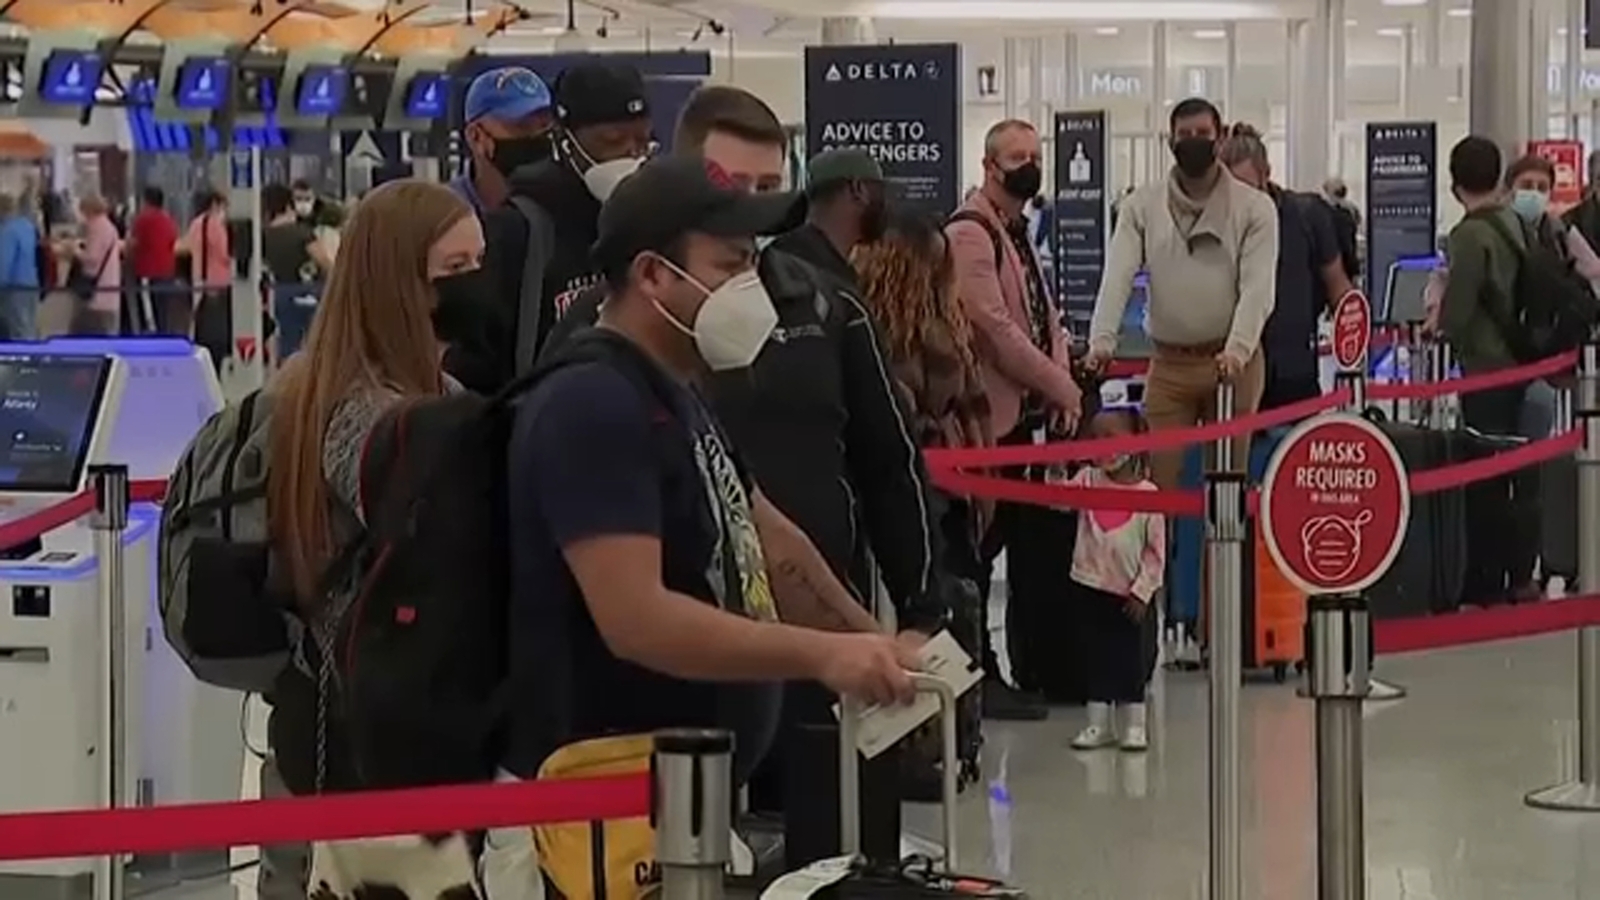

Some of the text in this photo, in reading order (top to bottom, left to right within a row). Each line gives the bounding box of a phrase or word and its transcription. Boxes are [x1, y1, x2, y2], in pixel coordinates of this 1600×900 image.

[848, 63, 917, 79] DELTA
[1091, 72, 1141, 93] Men
[822, 121, 925, 142] ADVICE TO
[822, 143, 941, 162] ENGERS
[1309, 441, 1367, 464] MASKS
[1296, 466, 1377, 490] REQUIRED
